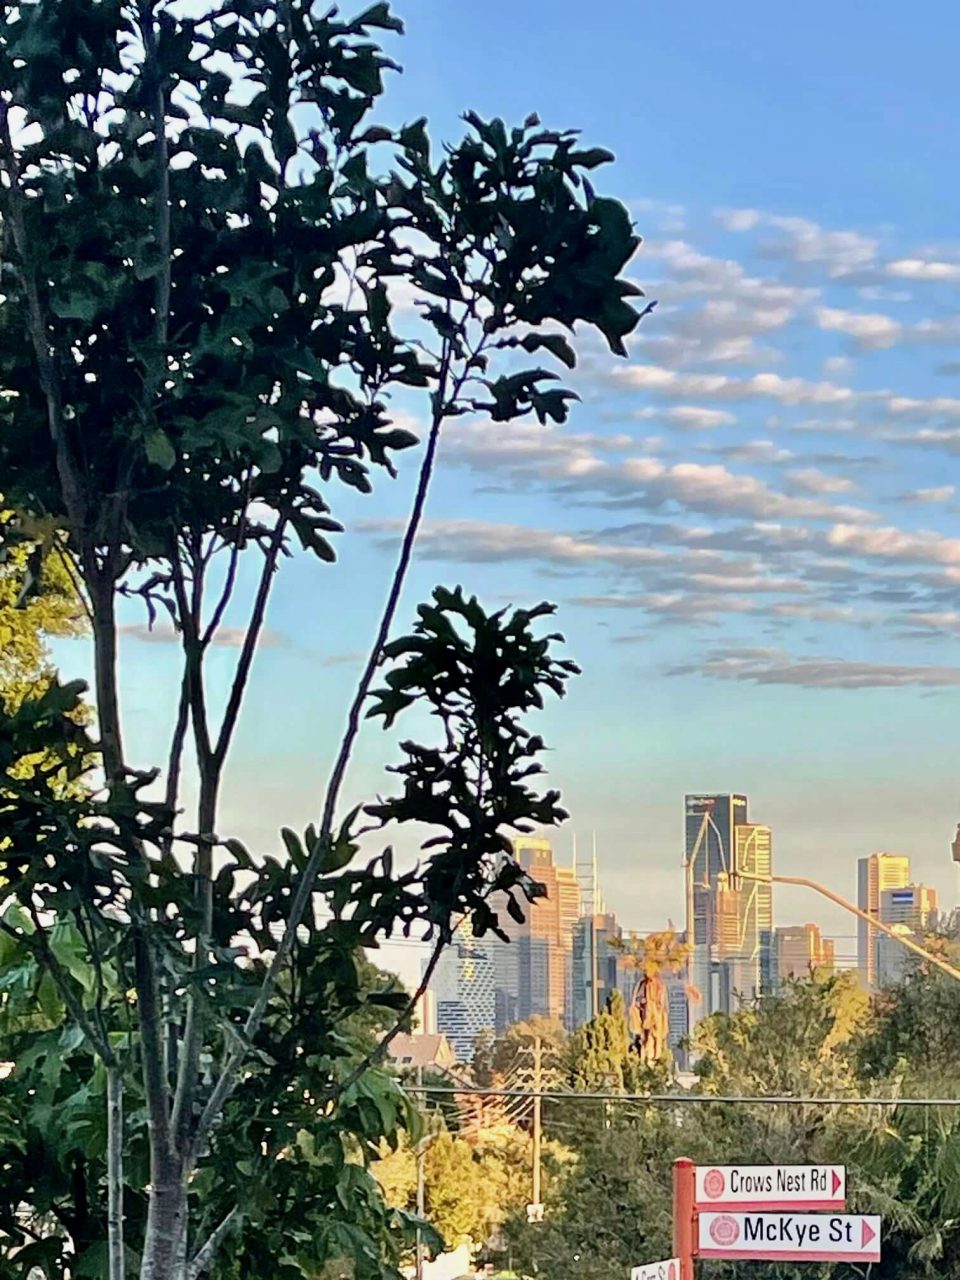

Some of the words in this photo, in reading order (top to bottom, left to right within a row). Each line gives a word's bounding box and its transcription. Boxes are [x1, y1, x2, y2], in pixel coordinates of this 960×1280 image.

[730, 1169, 772, 1193] Crows
[777, 1169, 806, 1192] Nest
[811, 1168, 827, 1191] Rd
[743, 1217, 820, 1247] McKye
[829, 1218, 853, 1243] St
